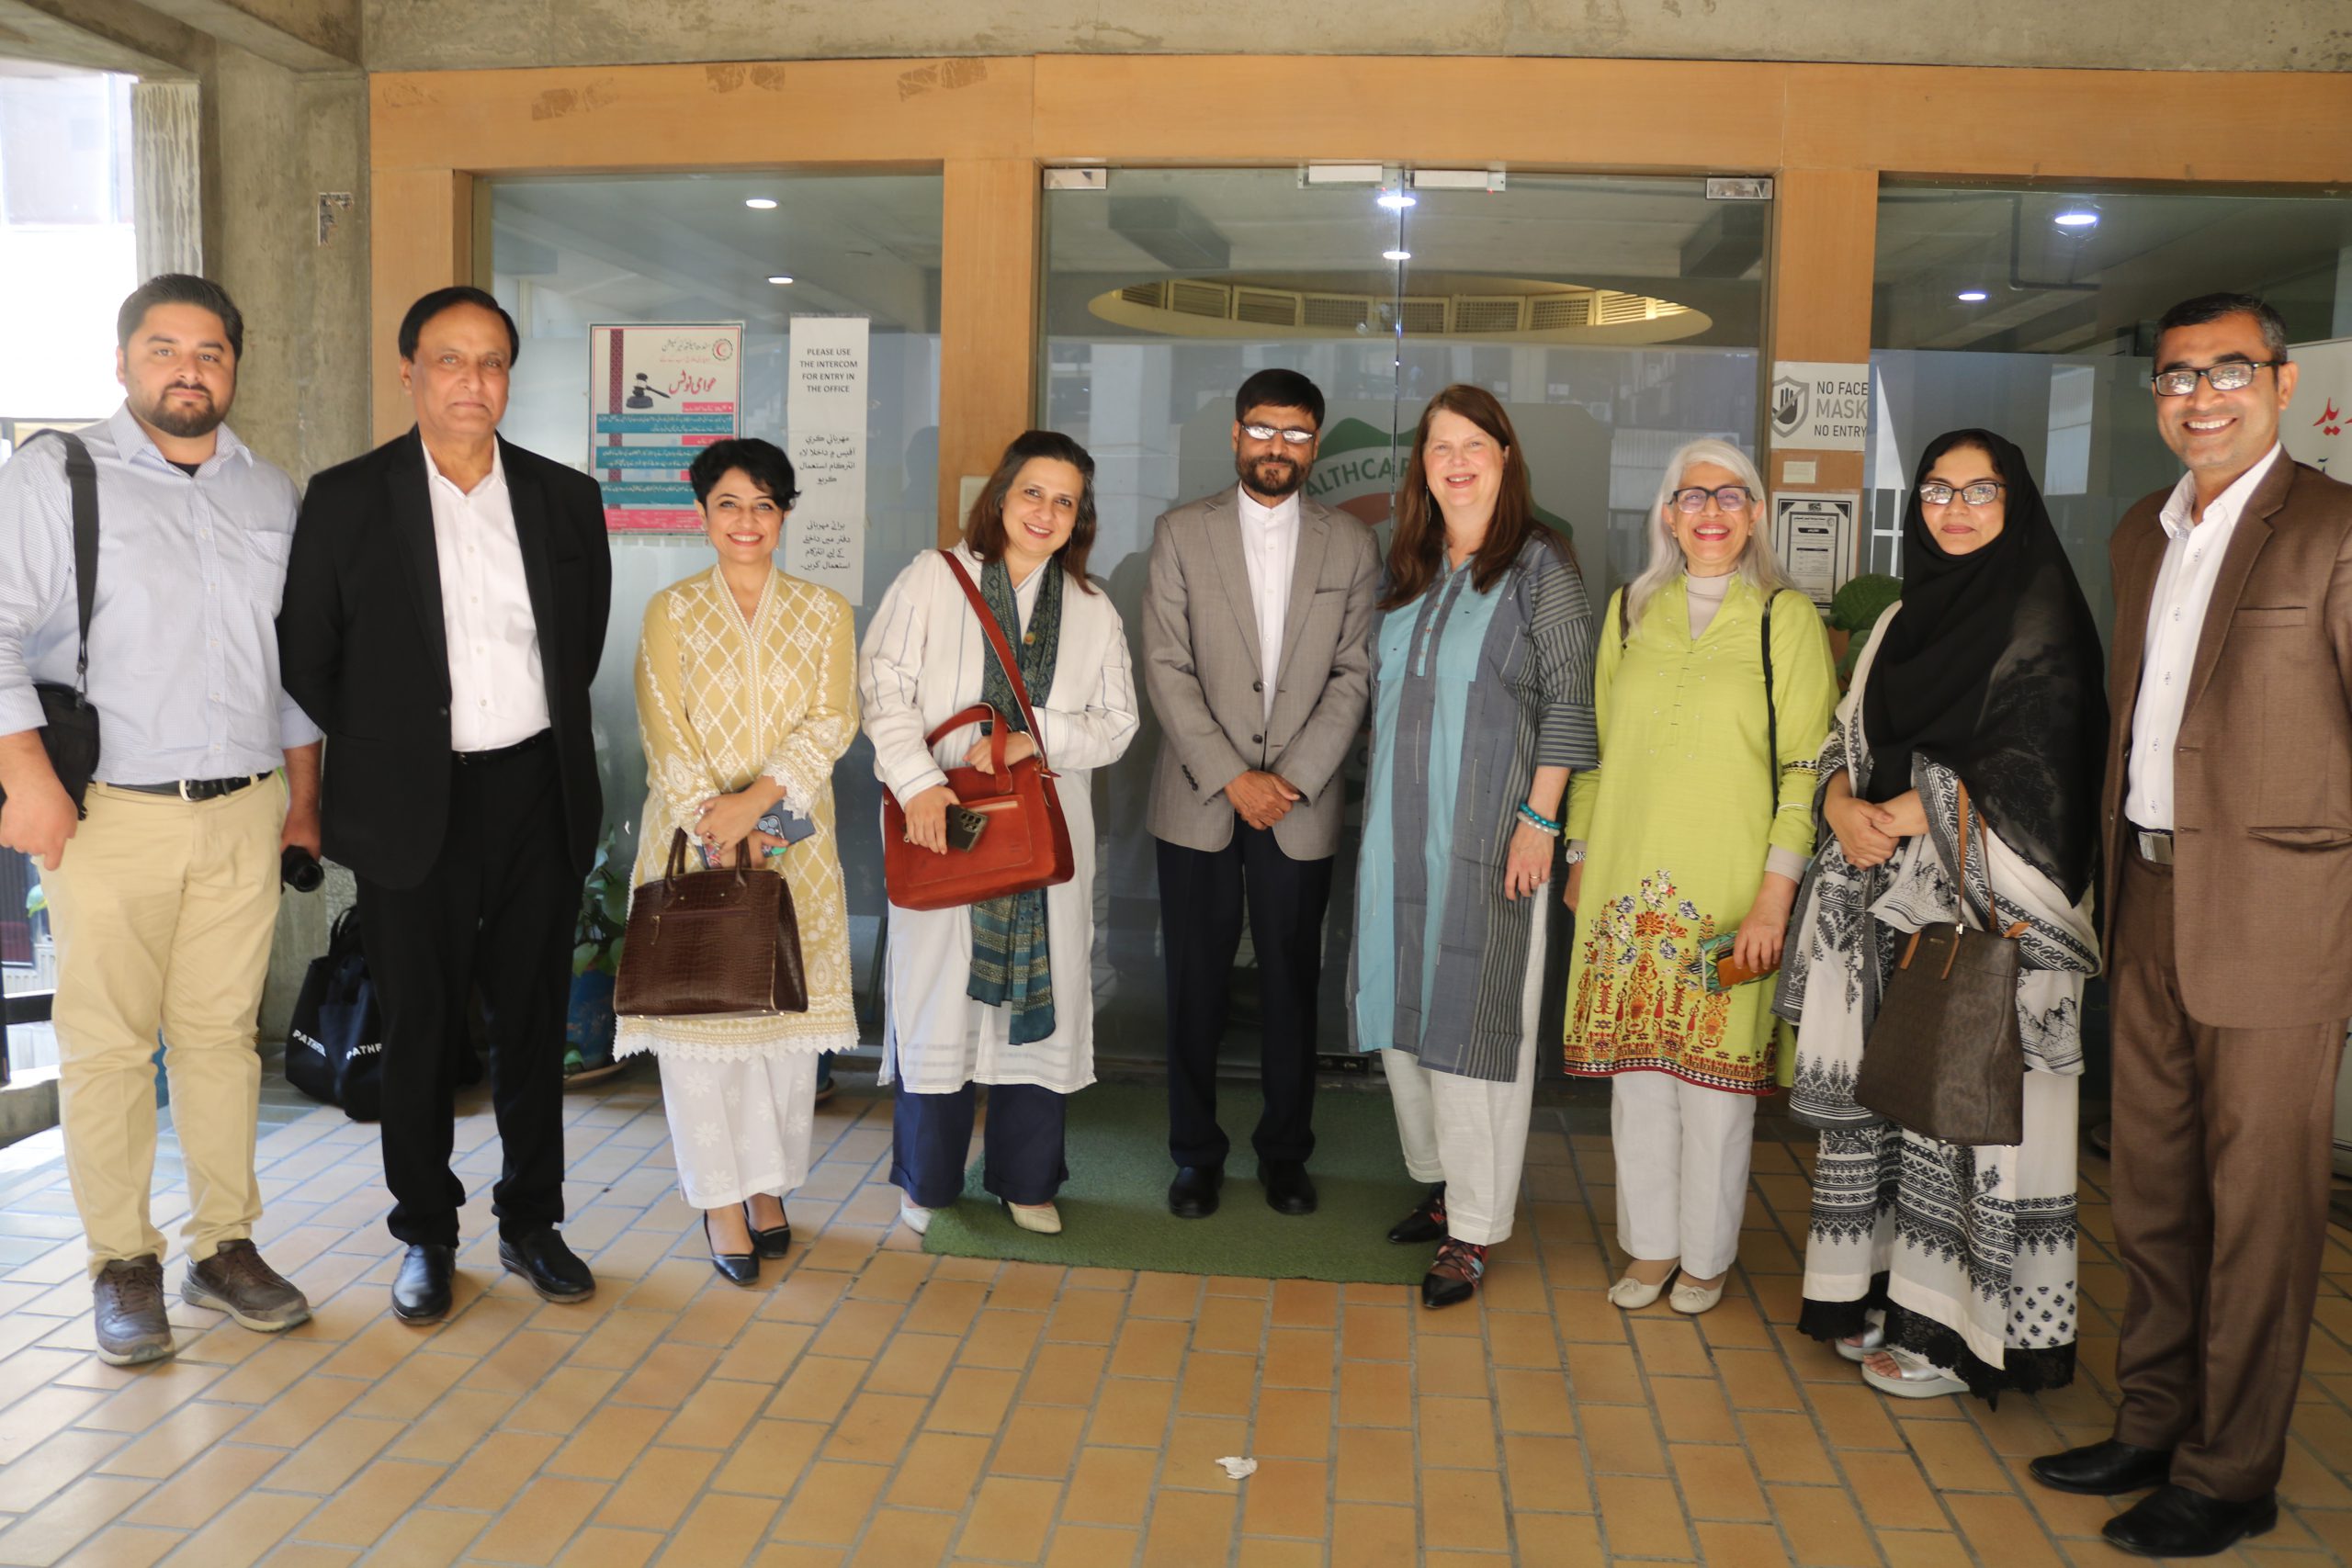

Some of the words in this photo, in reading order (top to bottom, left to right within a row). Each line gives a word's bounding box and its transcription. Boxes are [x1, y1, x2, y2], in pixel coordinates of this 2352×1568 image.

[816, 360, 858, 368] INTERCOM
[1816, 380, 1834, 395] NO
[1838, 381, 1869, 396] FACE
[1816, 398, 1868, 420] MASK
[1814, 424, 1829, 436] NO
[1833, 424, 1868, 438] ENTRY
